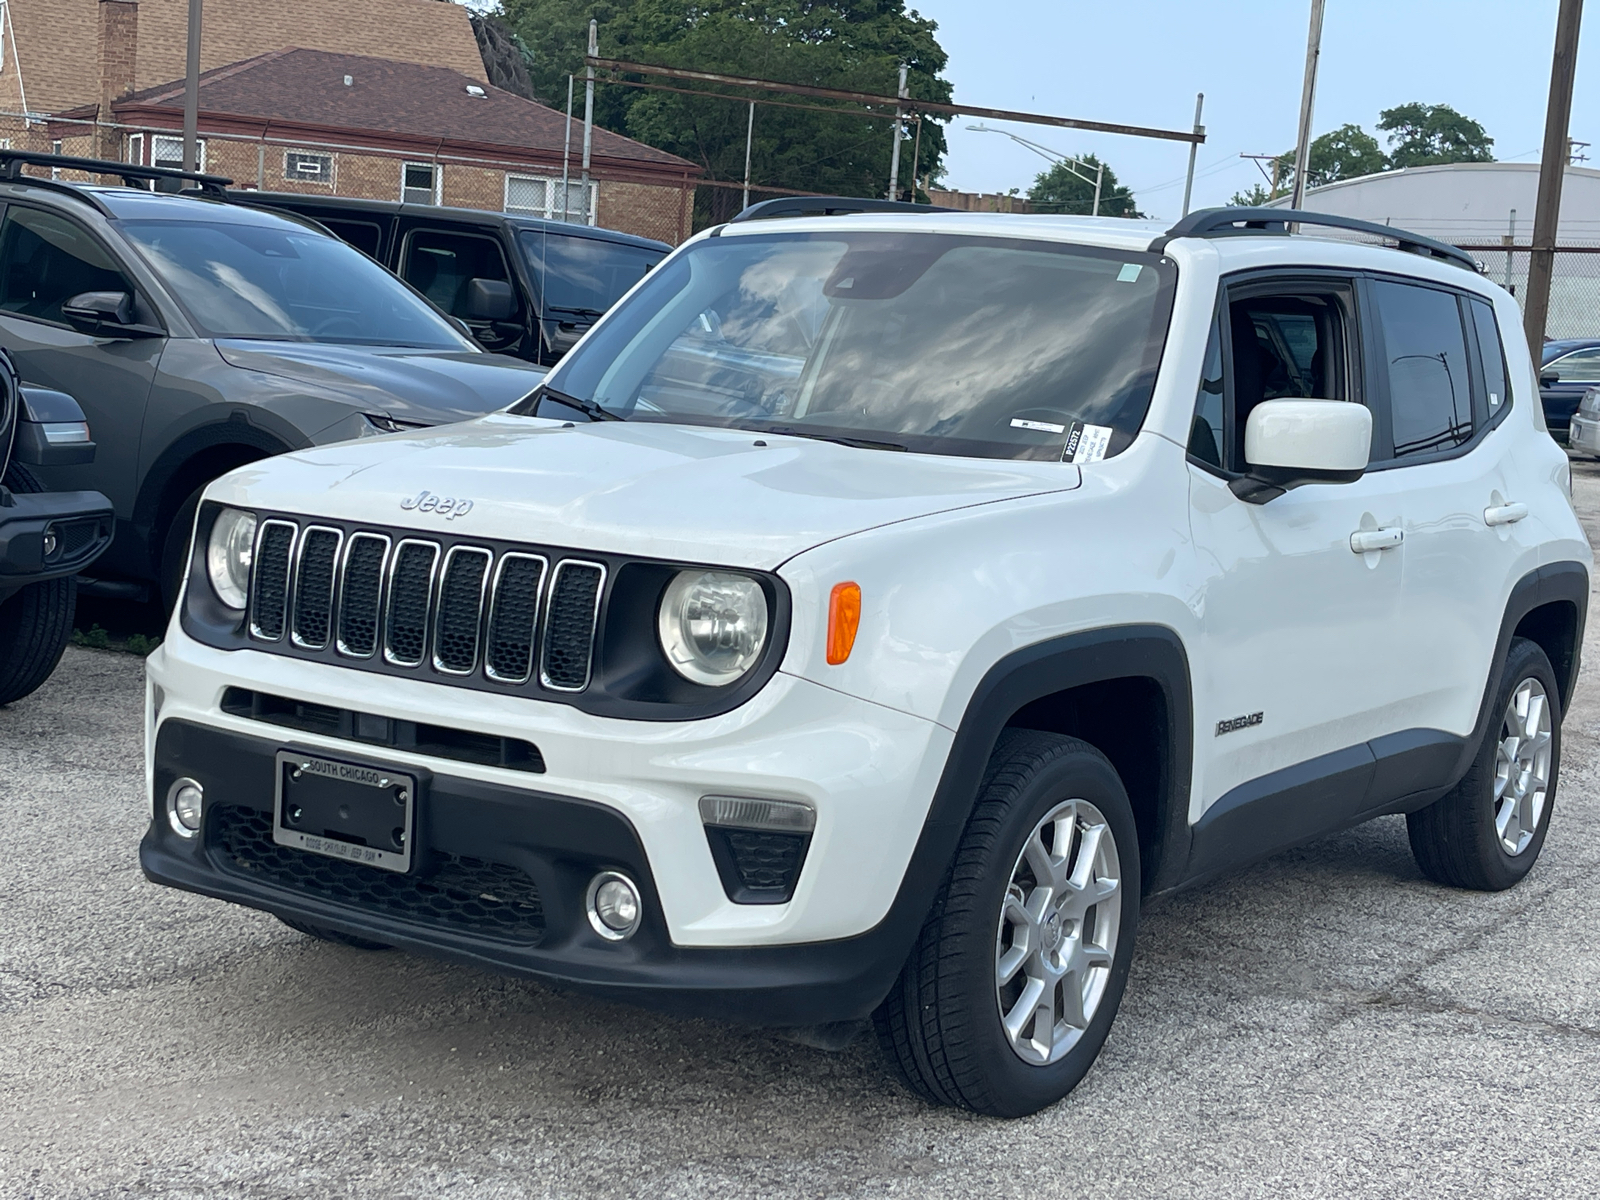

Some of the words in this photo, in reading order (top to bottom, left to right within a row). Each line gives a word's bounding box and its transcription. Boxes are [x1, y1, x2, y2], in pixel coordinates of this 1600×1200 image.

[1065, 430, 1081, 456] P22572
[400, 490, 474, 521] Jeep
[1214, 711, 1264, 738] RENEGADE
[309, 759, 339, 776] SOUTH
[340, 766, 379, 784] CHICAGO
